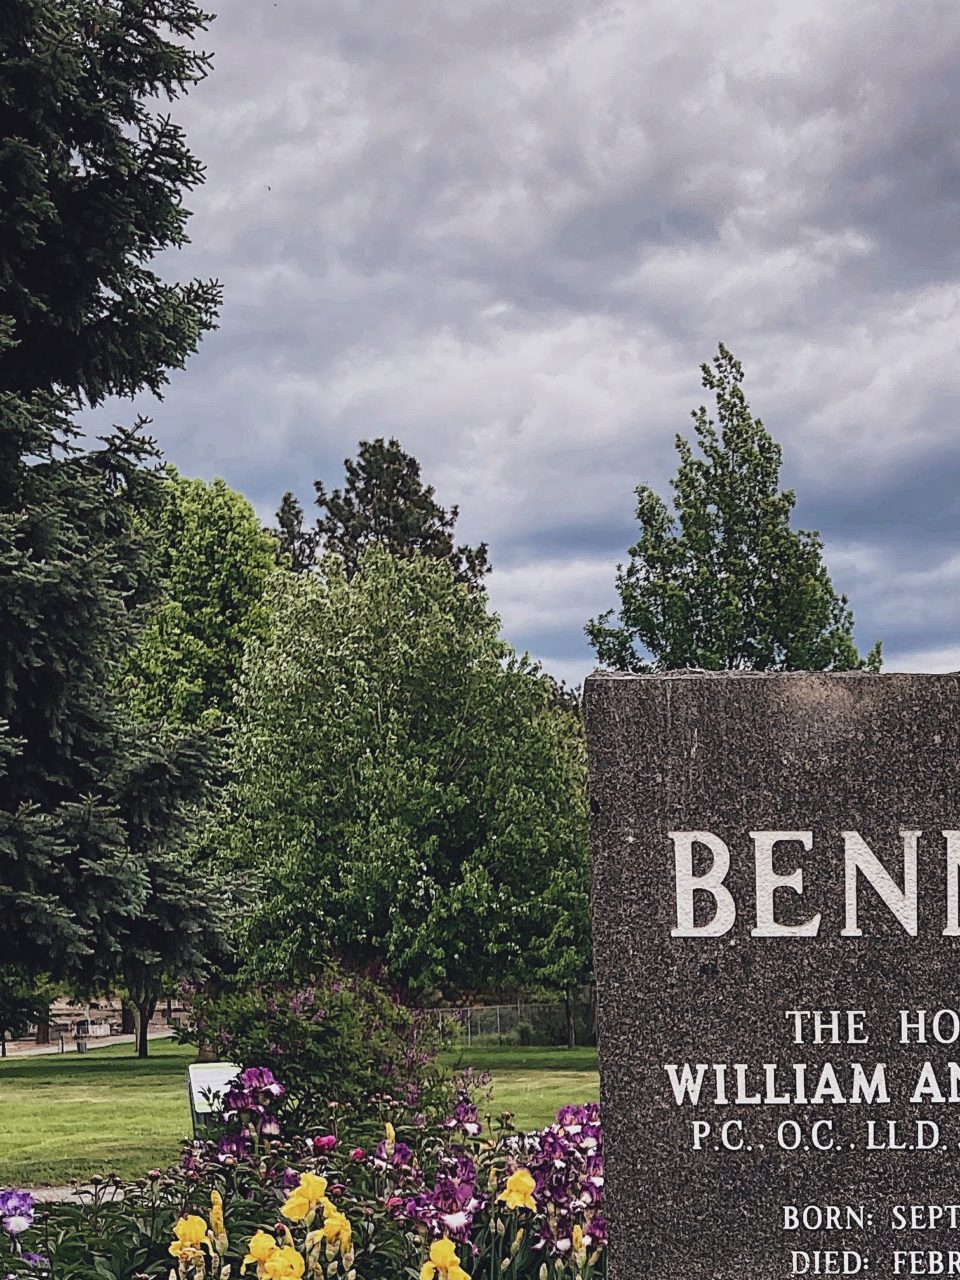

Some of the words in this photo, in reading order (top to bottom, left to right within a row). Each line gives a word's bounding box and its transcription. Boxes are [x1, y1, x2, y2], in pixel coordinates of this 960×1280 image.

[786, 1009, 868, 1044] THE
[664, 1062, 890, 1105] WILLIAM
[783, 1205, 873, 1230] BORN:
[791, 1251, 870, 1275] DIED:
